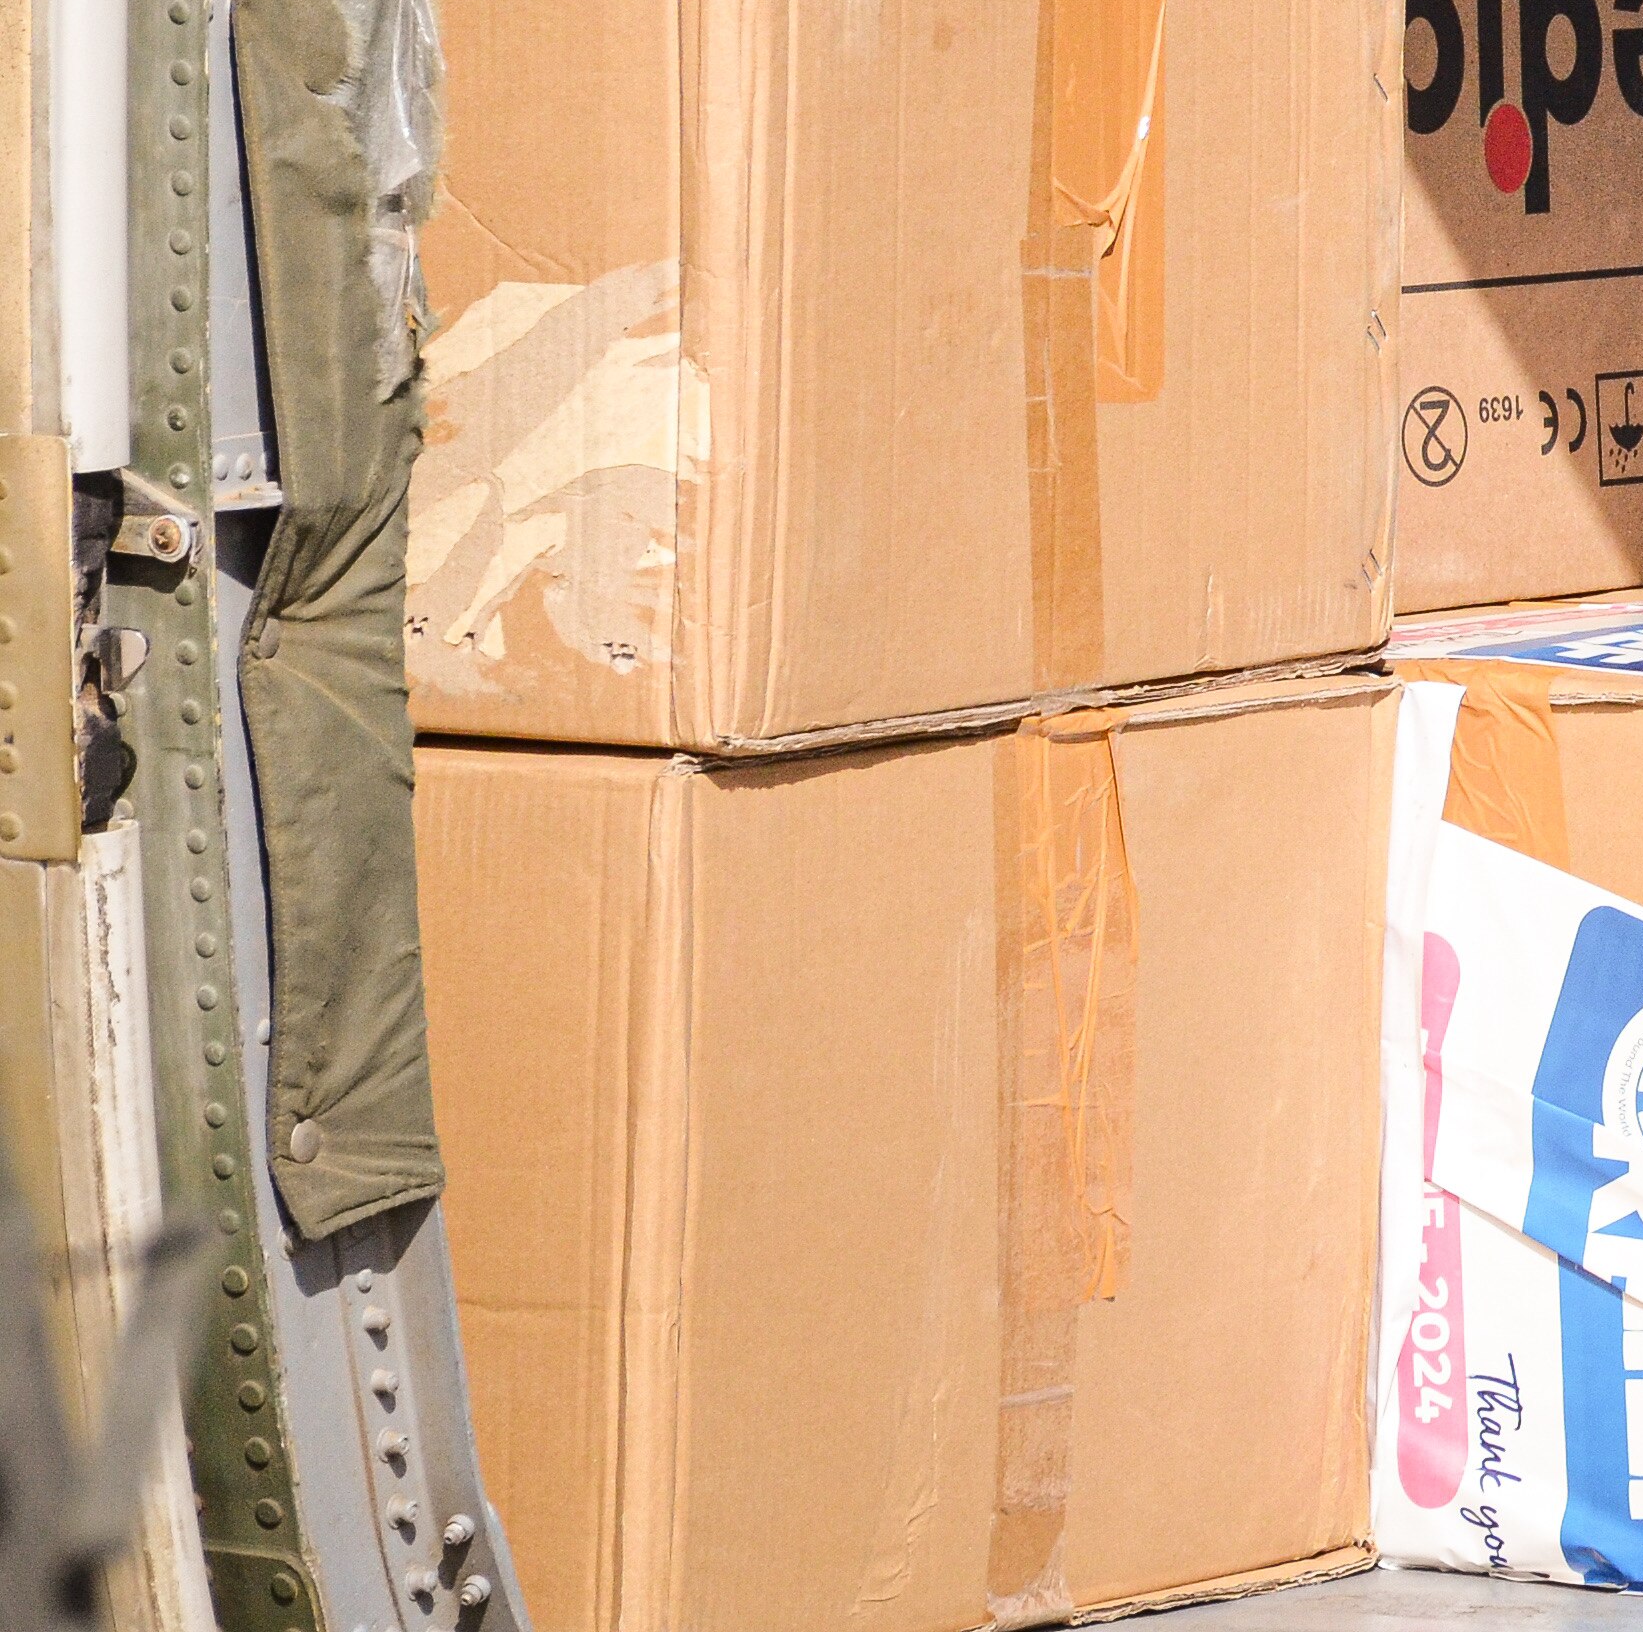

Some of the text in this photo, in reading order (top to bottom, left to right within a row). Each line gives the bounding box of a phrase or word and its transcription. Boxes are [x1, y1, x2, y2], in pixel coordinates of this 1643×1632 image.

[1477, 393, 1524, 424] 1639
[1618, 1071, 1631, 1095] The
[1410, 1276, 1451, 1426] 2024
[1467, 1351, 1522, 1494] Thank
